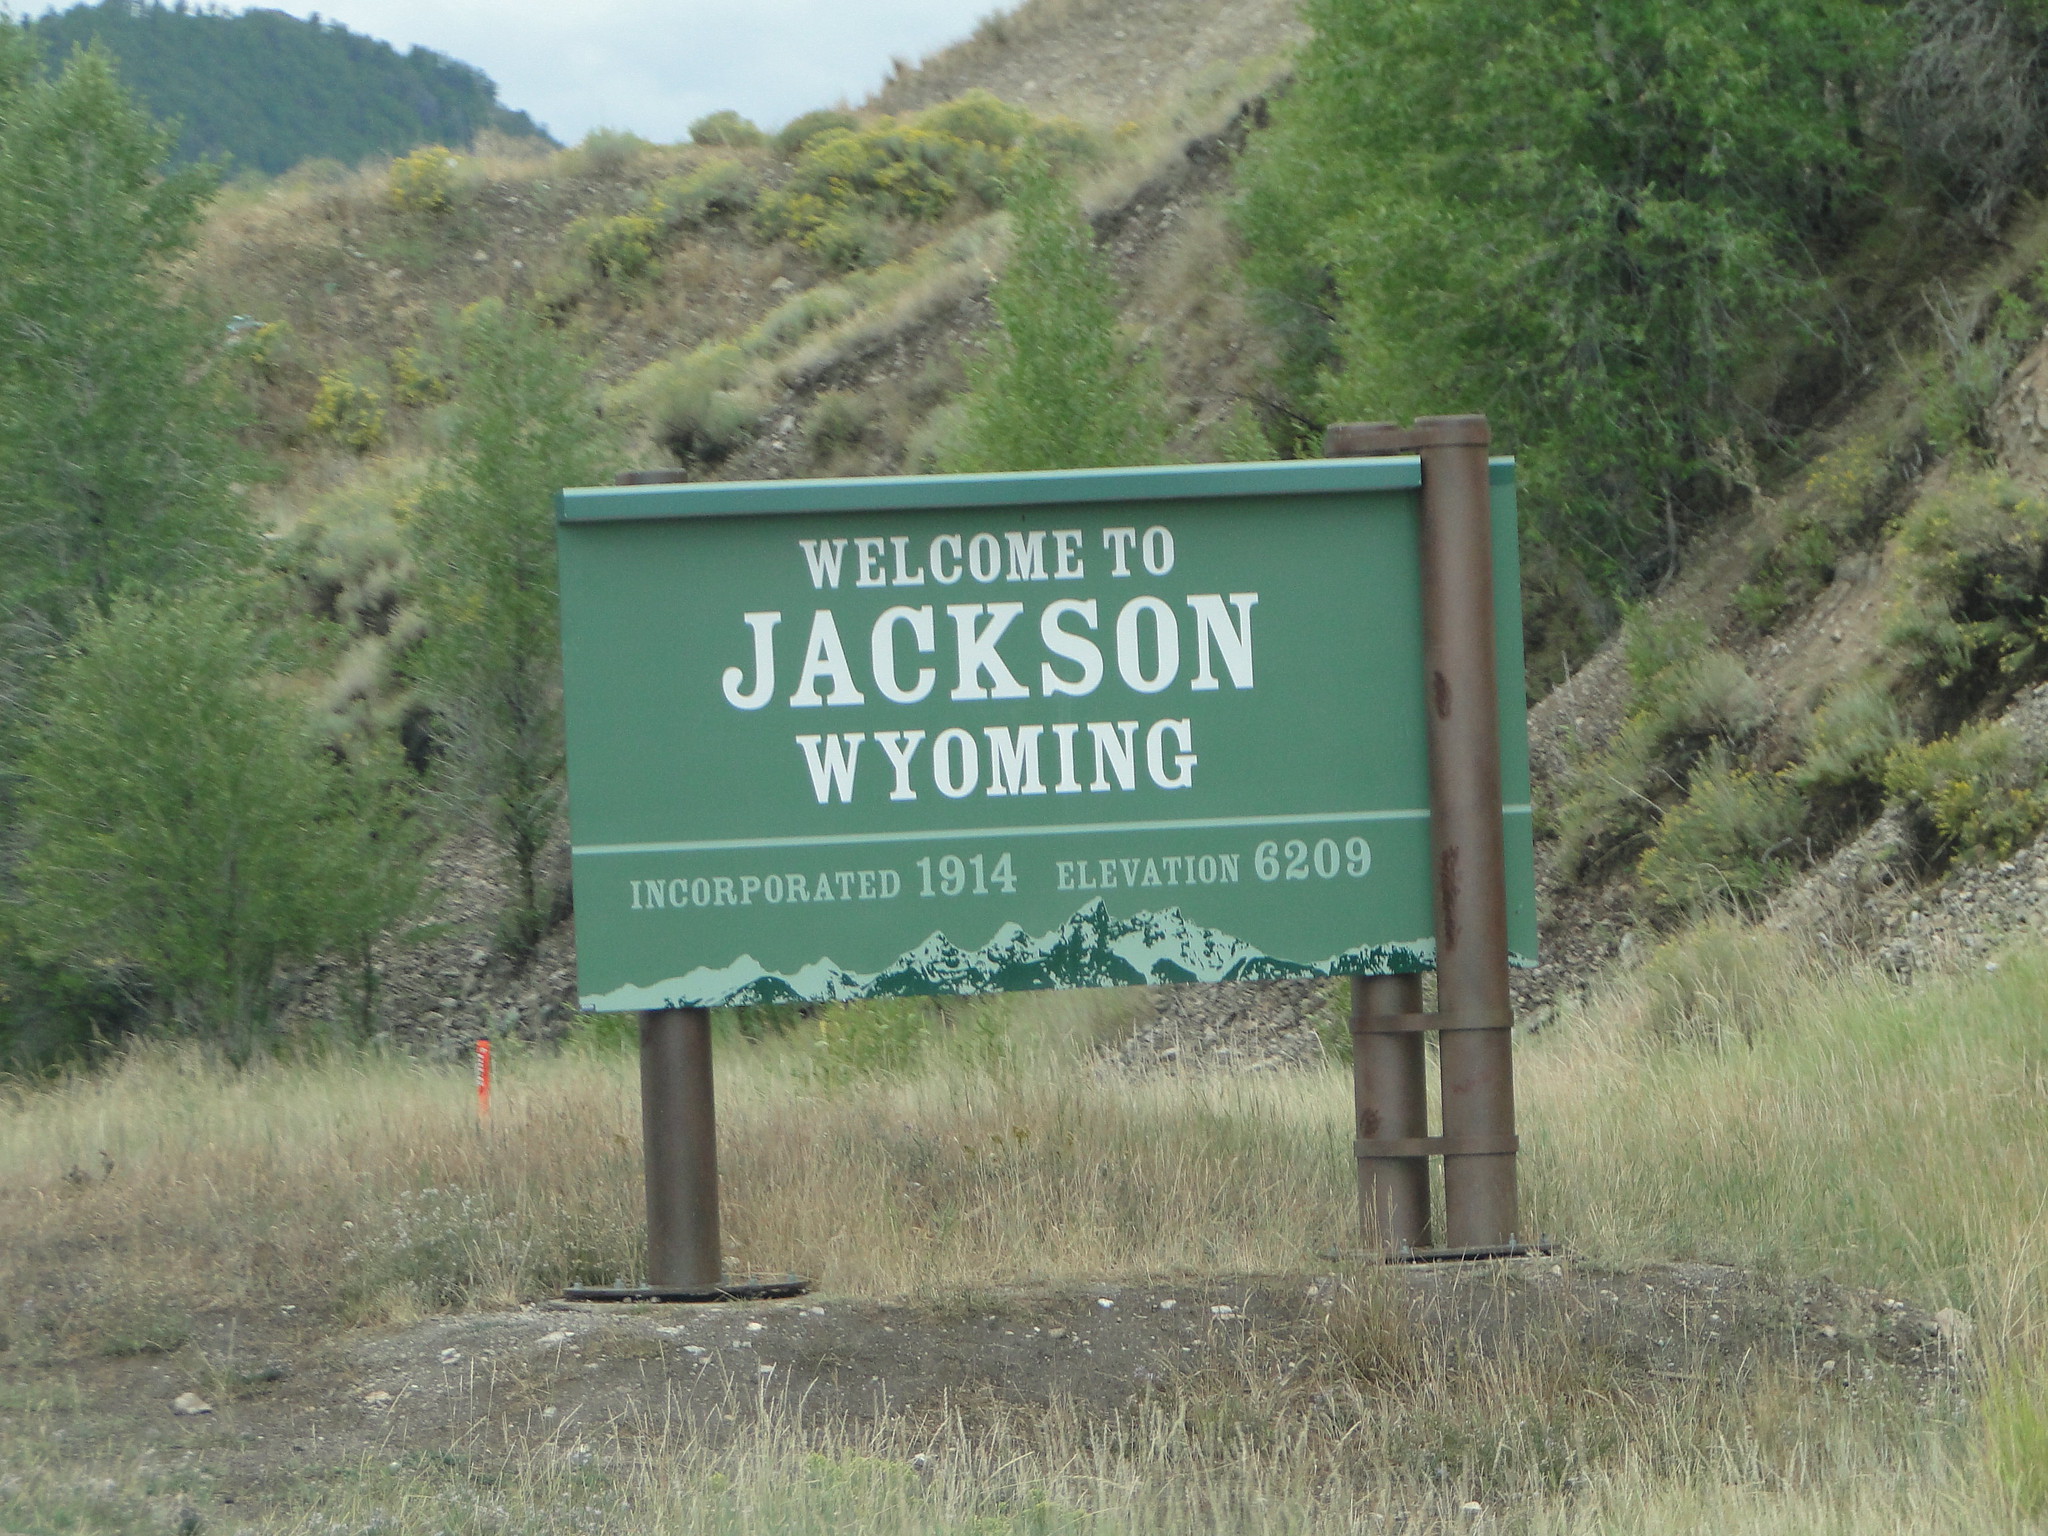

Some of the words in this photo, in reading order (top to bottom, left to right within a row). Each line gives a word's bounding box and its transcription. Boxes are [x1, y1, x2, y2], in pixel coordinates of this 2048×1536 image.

[799, 530, 1084, 589] WELCOME
[1103, 527, 1176, 577] TO
[722, 592, 1260, 710] JACKSON
[795, 718, 1199, 804] WYOMING
[630, 869, 901, 912] INCORPORATED
[916, 853, 1018, 897] 1914
[1056, 853, 1240, 891] ELEVATION
[1254, 837, 1372, 881] 6209
